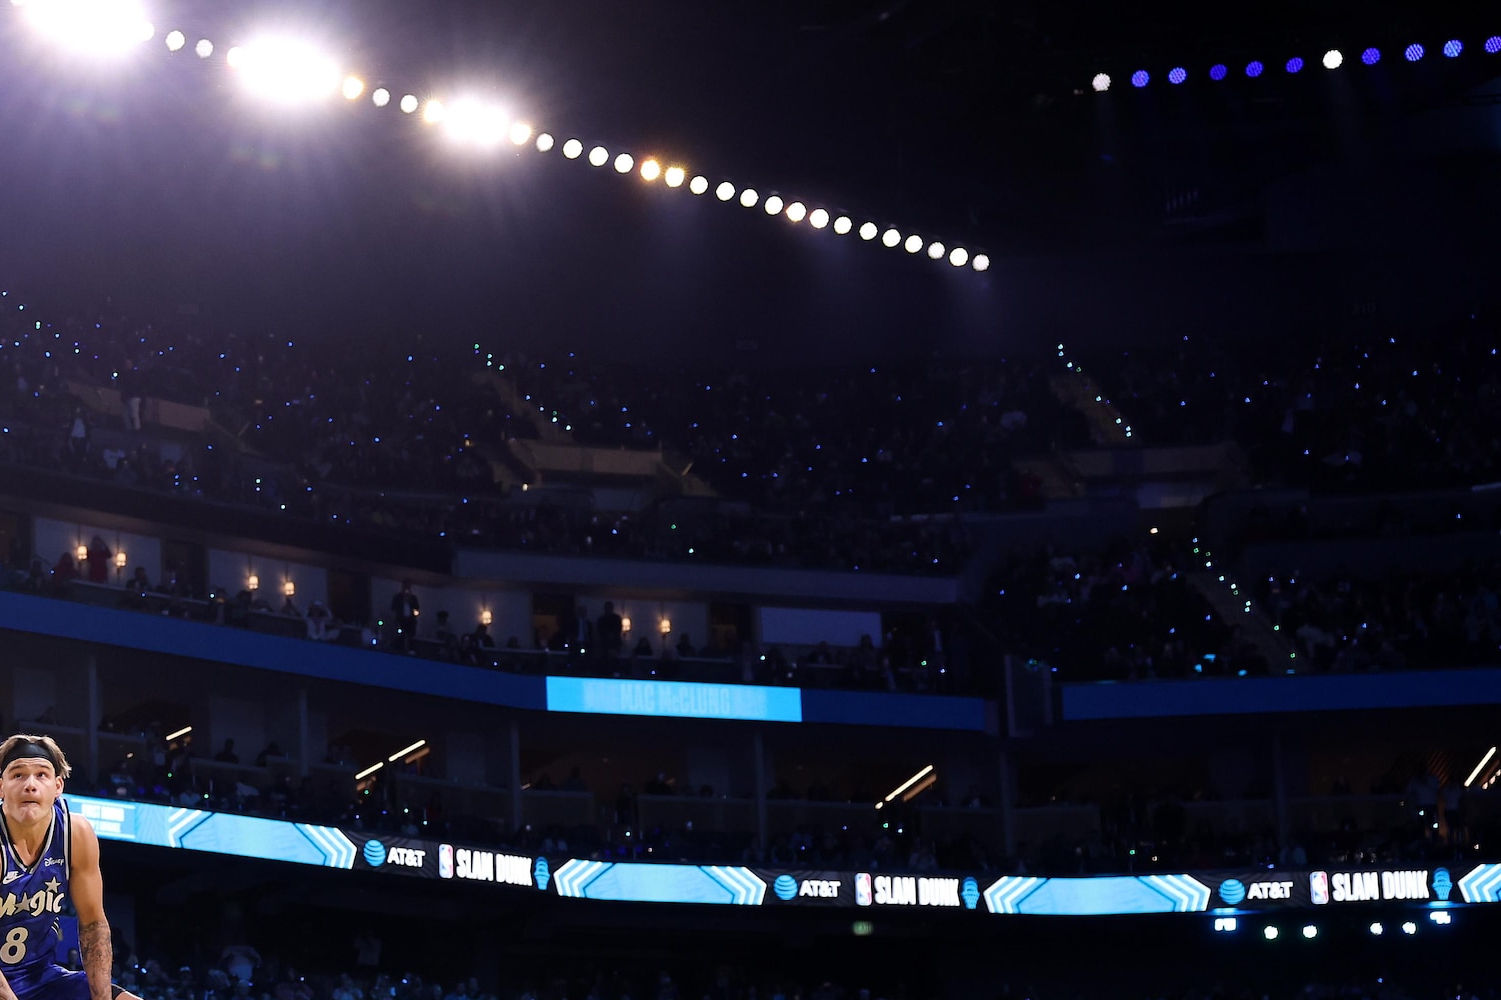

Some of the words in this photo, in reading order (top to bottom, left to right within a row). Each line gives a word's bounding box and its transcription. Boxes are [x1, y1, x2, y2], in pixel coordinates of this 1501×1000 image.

[387, 847, 425, 868] AT&T
[456, 849, 494, 882] SLAM
[496, 853, 532, 887] DUNK
[799, 880, 841, 898] AT&T
[874, 875, 916, 906] SLAM
[918, 877, 960, 907] DUNK
[1247, 881, 1293, 900] AT&T
[1332, 871, 1379, 902] SLAM
[1381, 870, 1429, 899] DUNK
[0, 926, 28, 965] 8
